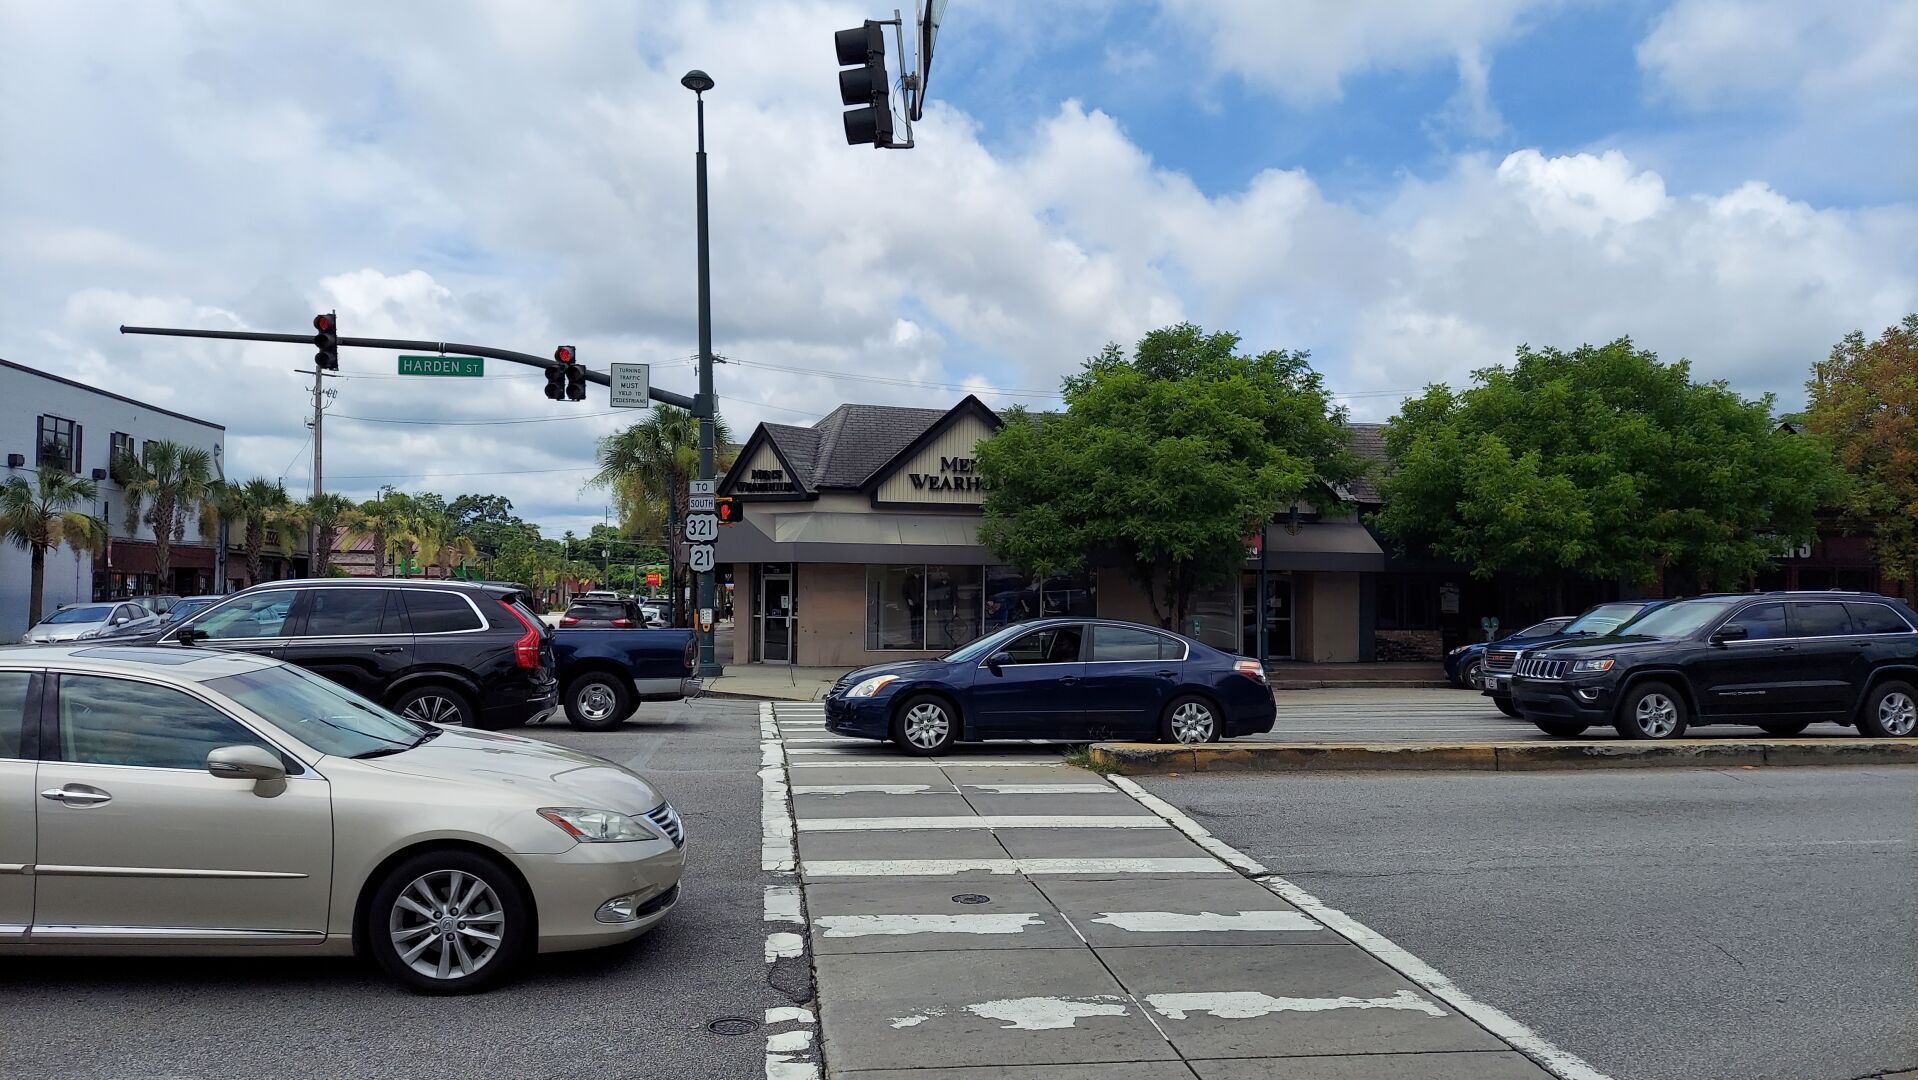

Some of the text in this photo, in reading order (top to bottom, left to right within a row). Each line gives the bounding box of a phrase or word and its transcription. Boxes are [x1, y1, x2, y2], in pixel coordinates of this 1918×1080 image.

[403, 360, 479, 373] HARDEN ST
[695, 483, 708, 492] TO
[690, 499, 714, 508] SOUTH
[688, 519, 712, 536] 321
[694, 550, 710, 566] 21
